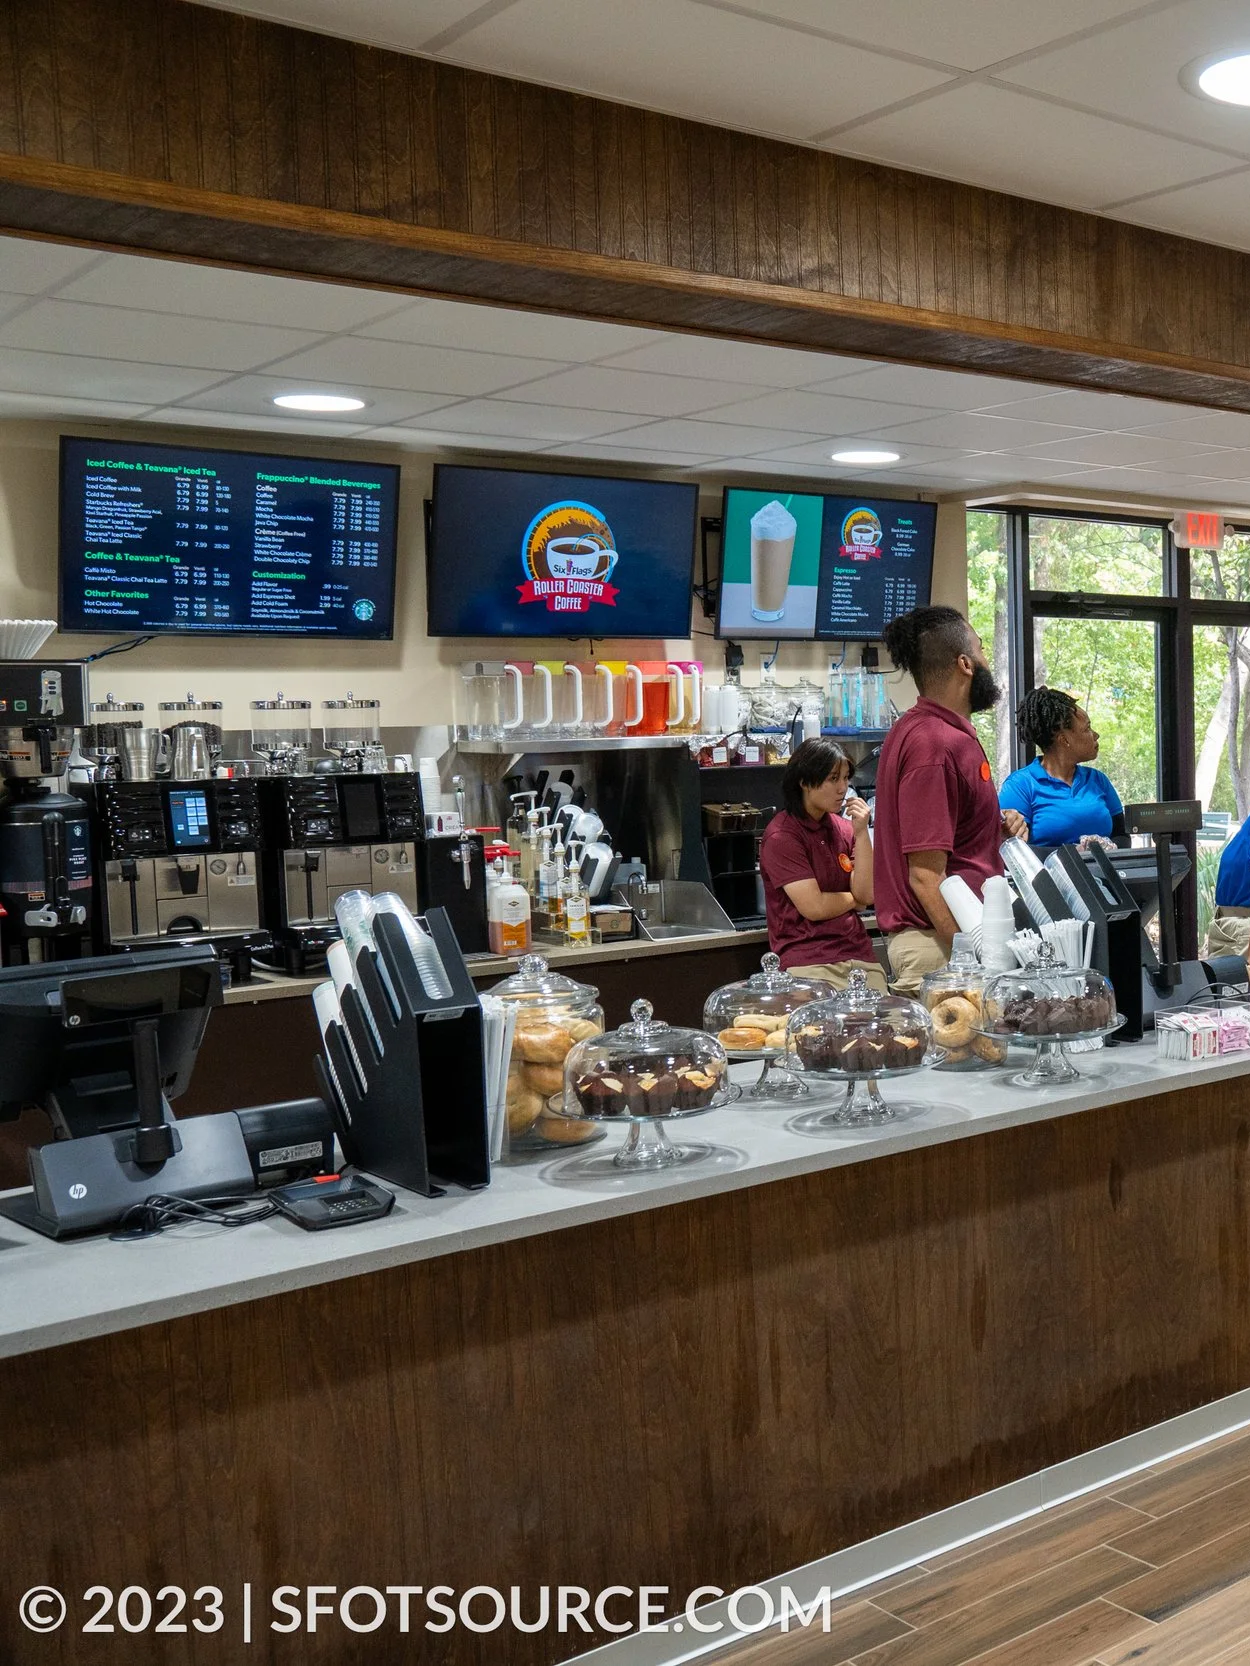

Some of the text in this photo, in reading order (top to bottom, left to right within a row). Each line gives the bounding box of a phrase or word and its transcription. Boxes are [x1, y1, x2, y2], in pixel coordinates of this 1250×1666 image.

[87, 459, 104, 467] Iced
[107, 461, 134, 470] Coffee
[144, 464, 182, 473] Teavana®
[202, 468, 216, 476] Tea
[310, 477, 340, 486] Blended
[342, 480, 381, 490] Beverages
[1187, 512, 1218, 545] EXIT
[85, 552, 114, 560] Coffee
[124, 554, 164, 562] Teavana®
[252, 571, 305, 580] Customization
[554, 565, 592, 576] Six Flags
[533, 580, 604, 596] ROLLER COASTER
[554, 595, 582, 610] COFFEE
